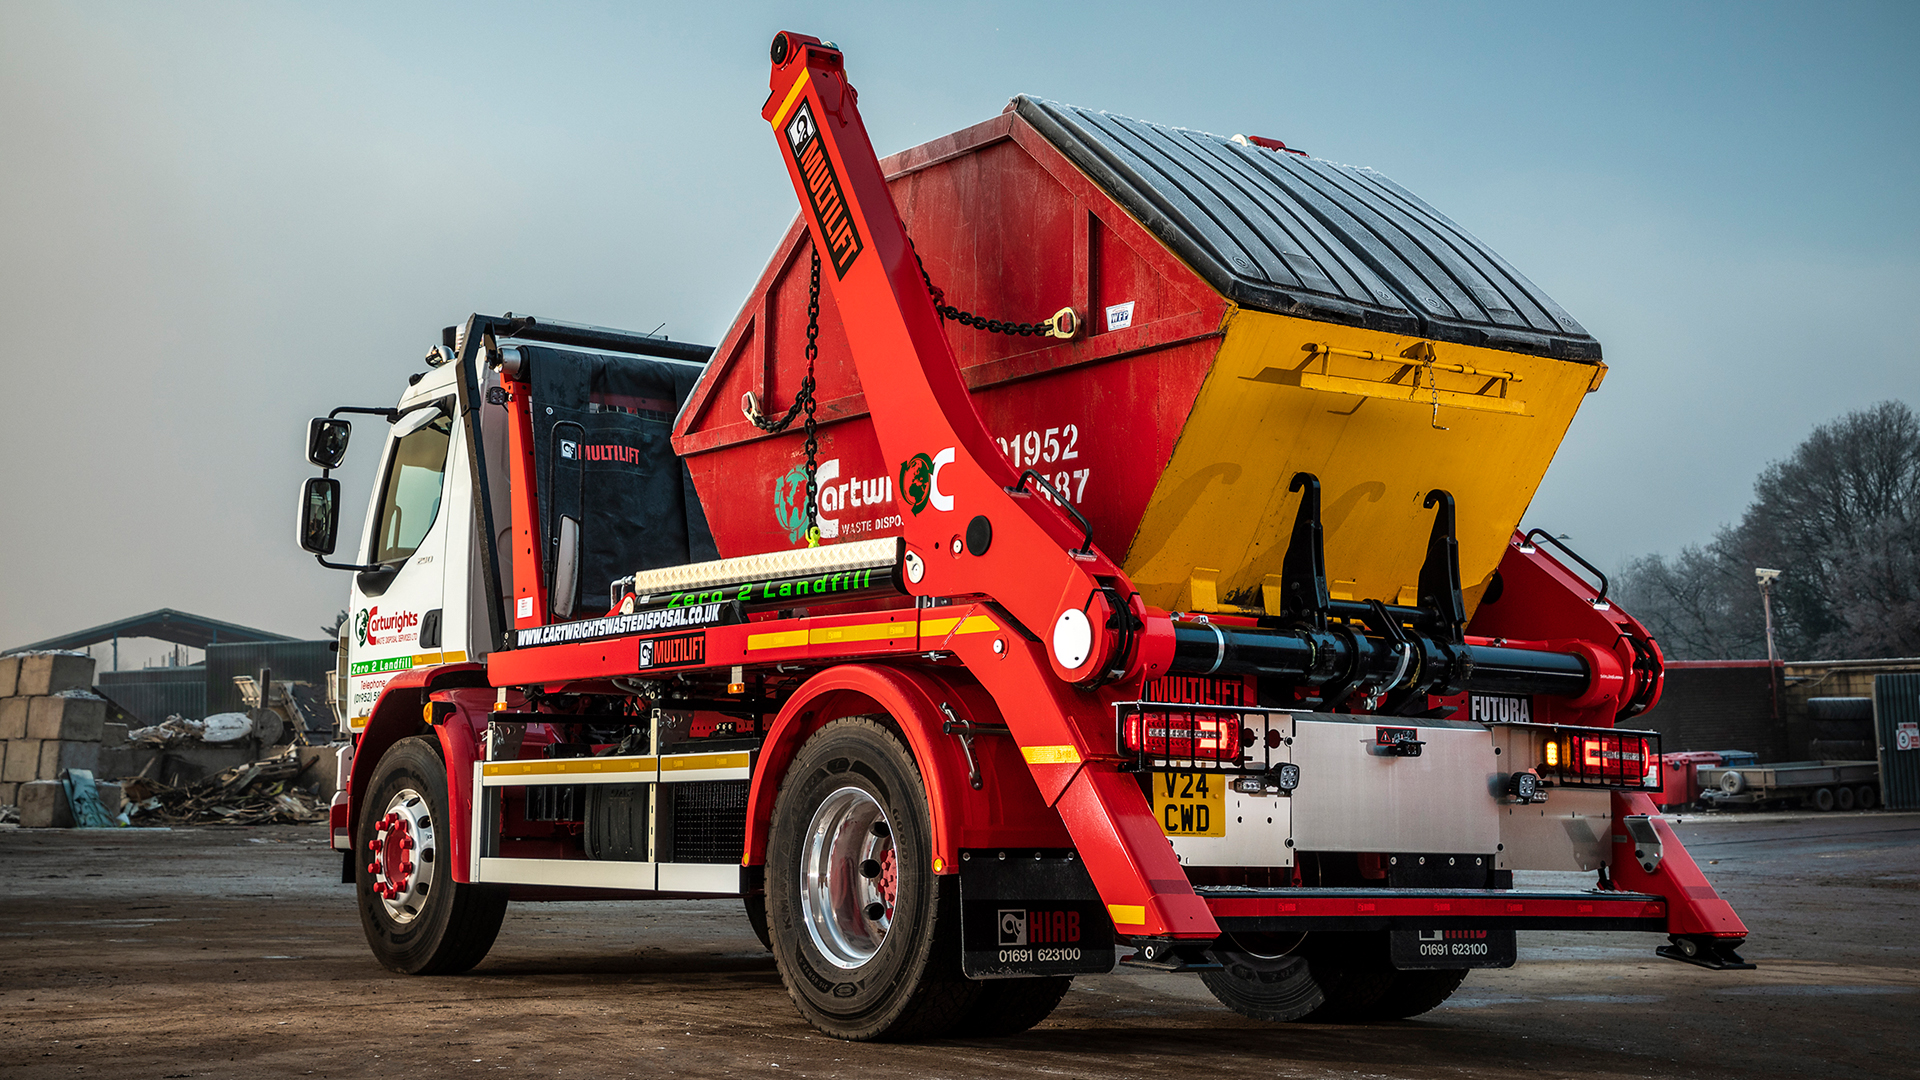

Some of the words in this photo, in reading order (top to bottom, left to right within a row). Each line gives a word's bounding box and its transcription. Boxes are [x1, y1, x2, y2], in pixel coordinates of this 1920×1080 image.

[800, 137, 858, 268] MULTILIFT
[578, 443, 640, 465] MULTILIFT
[841, 520, 872, 535] WASTE
[875, 514, 905, 530] DISPO
[667, 590, 724, 609] Zero
[737, 583, 753, 601] 2
[763, 568, 872, 599] Landfill
[366, 605, 418, 646] Cartwrights
[517, 603, 721, 647] WWW.CARTWRIGHTSWASTEDISPOSAL.CO.UK
[653, 636, 705, 664] MULTILIFT
[352, 663, 369, 675] Zero
[372, 661, 377, 672] 2
[380, 656, 411, 671] Landfill
[1150, 675, 1241, 706] MULTILIFT
[1471, 695, 1530, 723] FUTURA
[1164, 772, 1209, 799] V24
[1164, 804, 1210, 832] CWD
[1029, 910, 1081, 943] HIAB
[999, 949, 1033, 963] 01691
[1037, 947, 1081, 962] 623100
[1419, 943, 1449, 956] 01691
[1451, 943, 1488, 956] 623100
